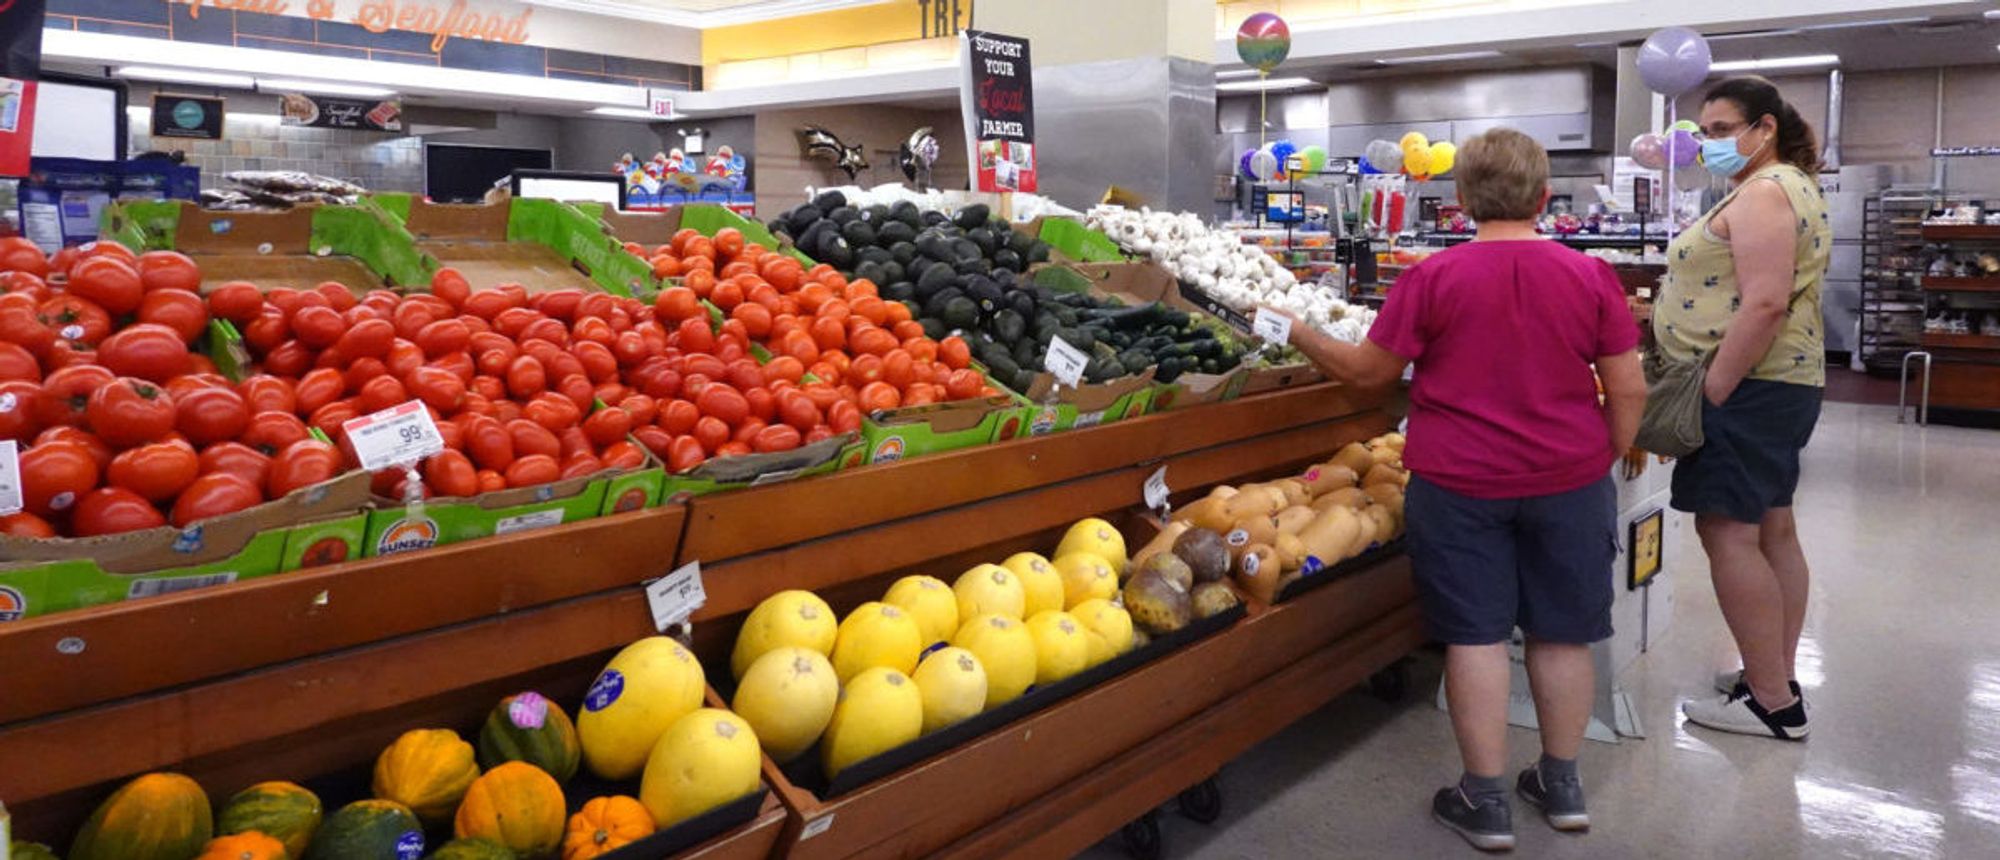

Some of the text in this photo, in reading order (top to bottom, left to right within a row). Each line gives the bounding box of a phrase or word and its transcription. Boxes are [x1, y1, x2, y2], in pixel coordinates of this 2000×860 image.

[353, 0, 534, 51] Seafood
[975, 37, 1022, 57] SUPPORT
[985, 58, 1014, 76] YOUR
[979, 77, 1025, 117] Local
[982, 119, 1024, 138] FARMER
[400, 425, 421, 442] 99
